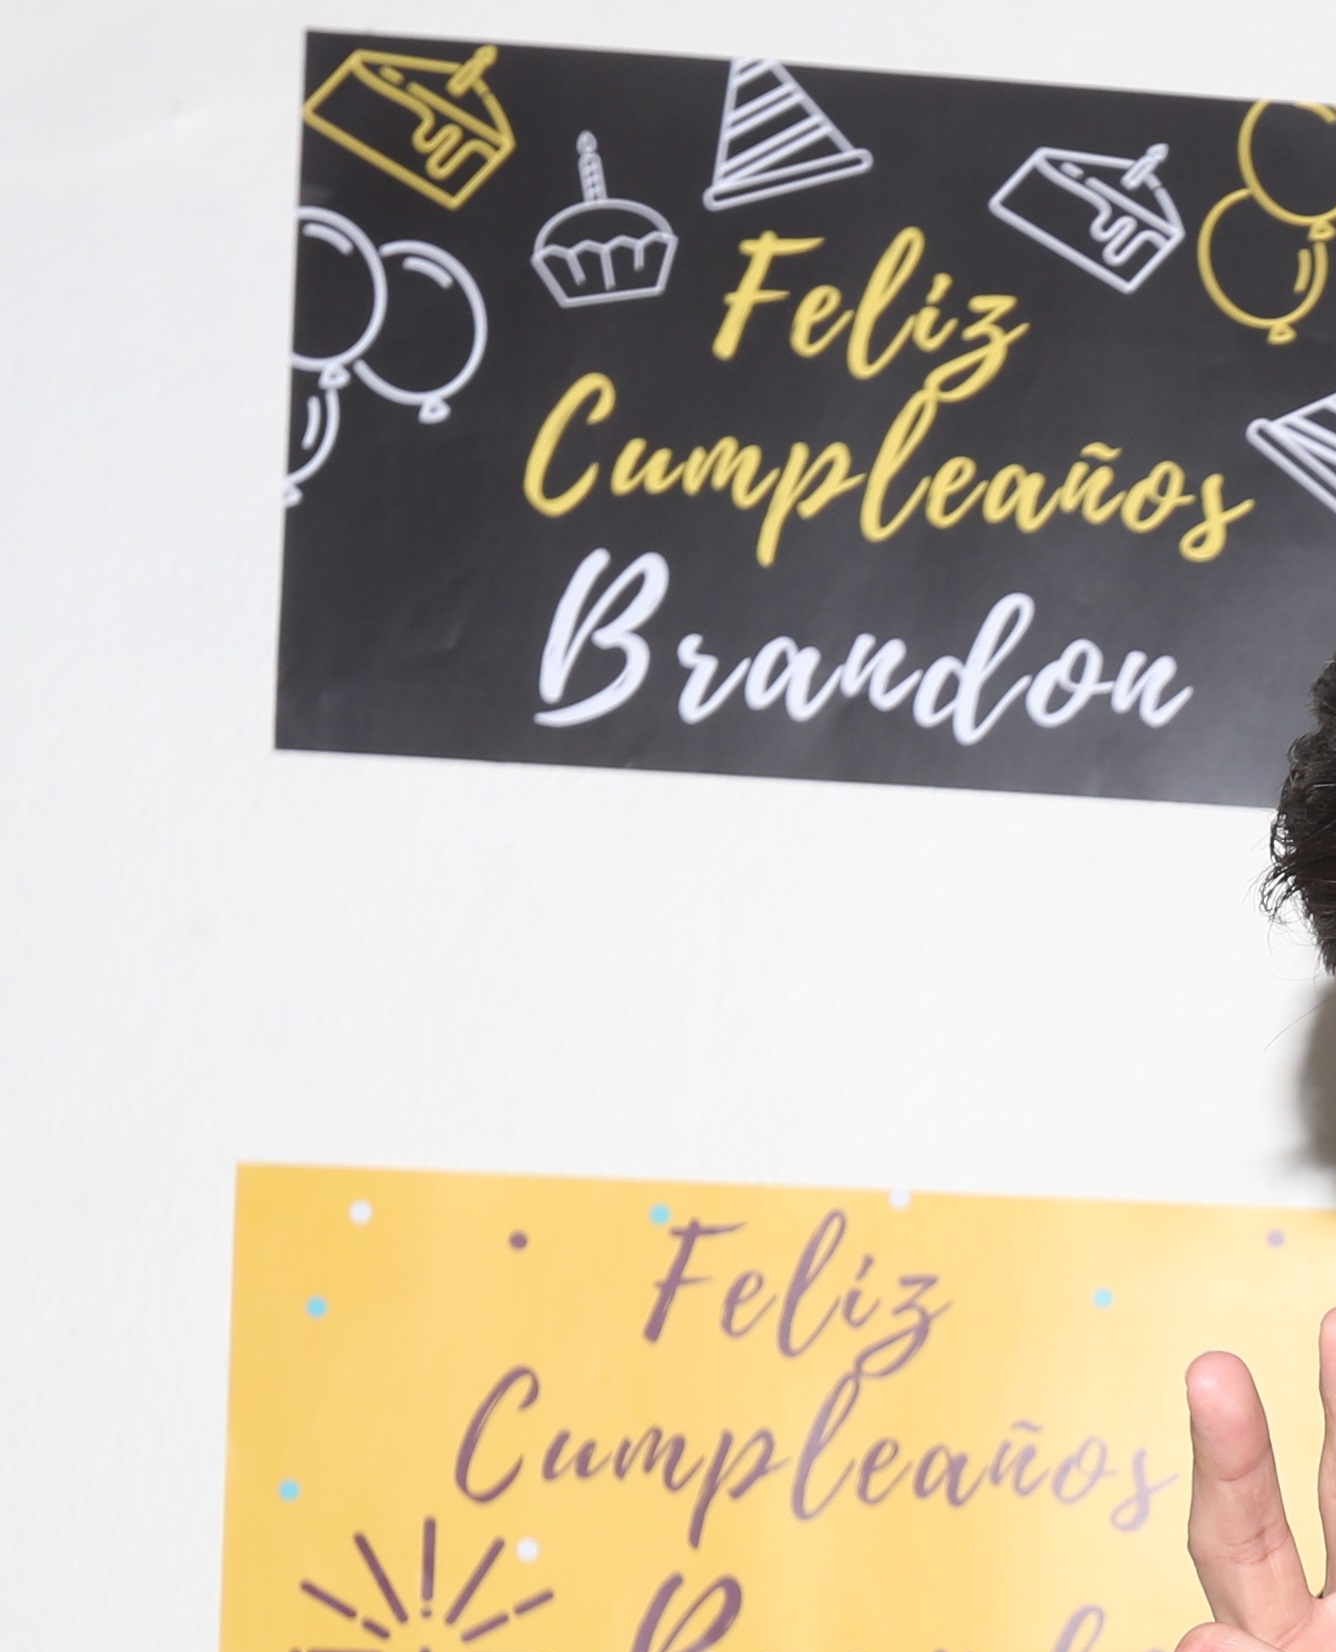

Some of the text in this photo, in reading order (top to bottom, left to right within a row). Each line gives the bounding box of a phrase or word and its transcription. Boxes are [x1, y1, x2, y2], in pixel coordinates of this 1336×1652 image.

[711, 226, 1030, 401] Feliz
[521, 372, 1254, 566] Cumpleaños
[533, 548, 1193, 746] Brandon
[642, 1210, 953, 1379] Feliz
[454, 1365, 1178, 1548] Cumpleaños
